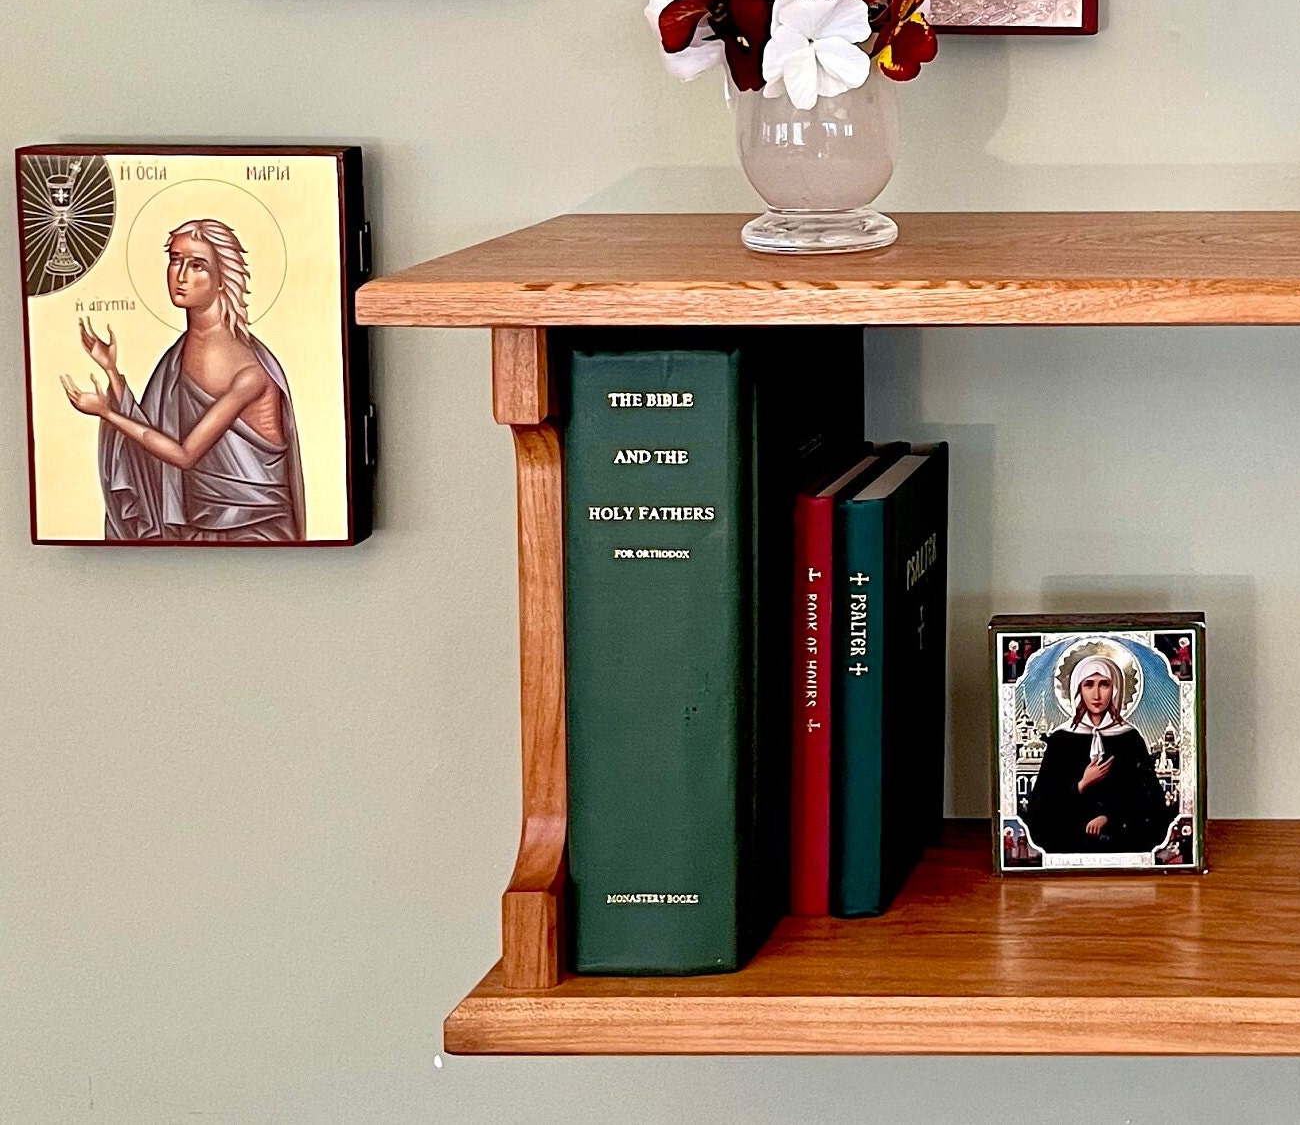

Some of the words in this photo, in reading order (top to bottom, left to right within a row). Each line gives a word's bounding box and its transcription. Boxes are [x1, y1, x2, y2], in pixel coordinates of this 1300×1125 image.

[608, 392, 643, 408] THE
[645, 392, 695, 408] BIBLE
[613, 450, 652, 465] AND
[654, 450, 690, 465] THE
[588, 506, 636, 521] HOLY
[637, 506, 716, 522] FATHERS
[613, 549, 636, 559] FOR
[636, 549, 691, 560] ORTHODOX
[906, 533, 938, 592] PSALTER
[805, 593, 819, 631] BOOK
[850, 594, 867, 657] PSALTER
[804, 637, 818, 655] OF
[803, 659, 818, 708] HOURS
[606, 893, 665, 904] MONASTERY
[666, 894, 700, 904] BOOKS
